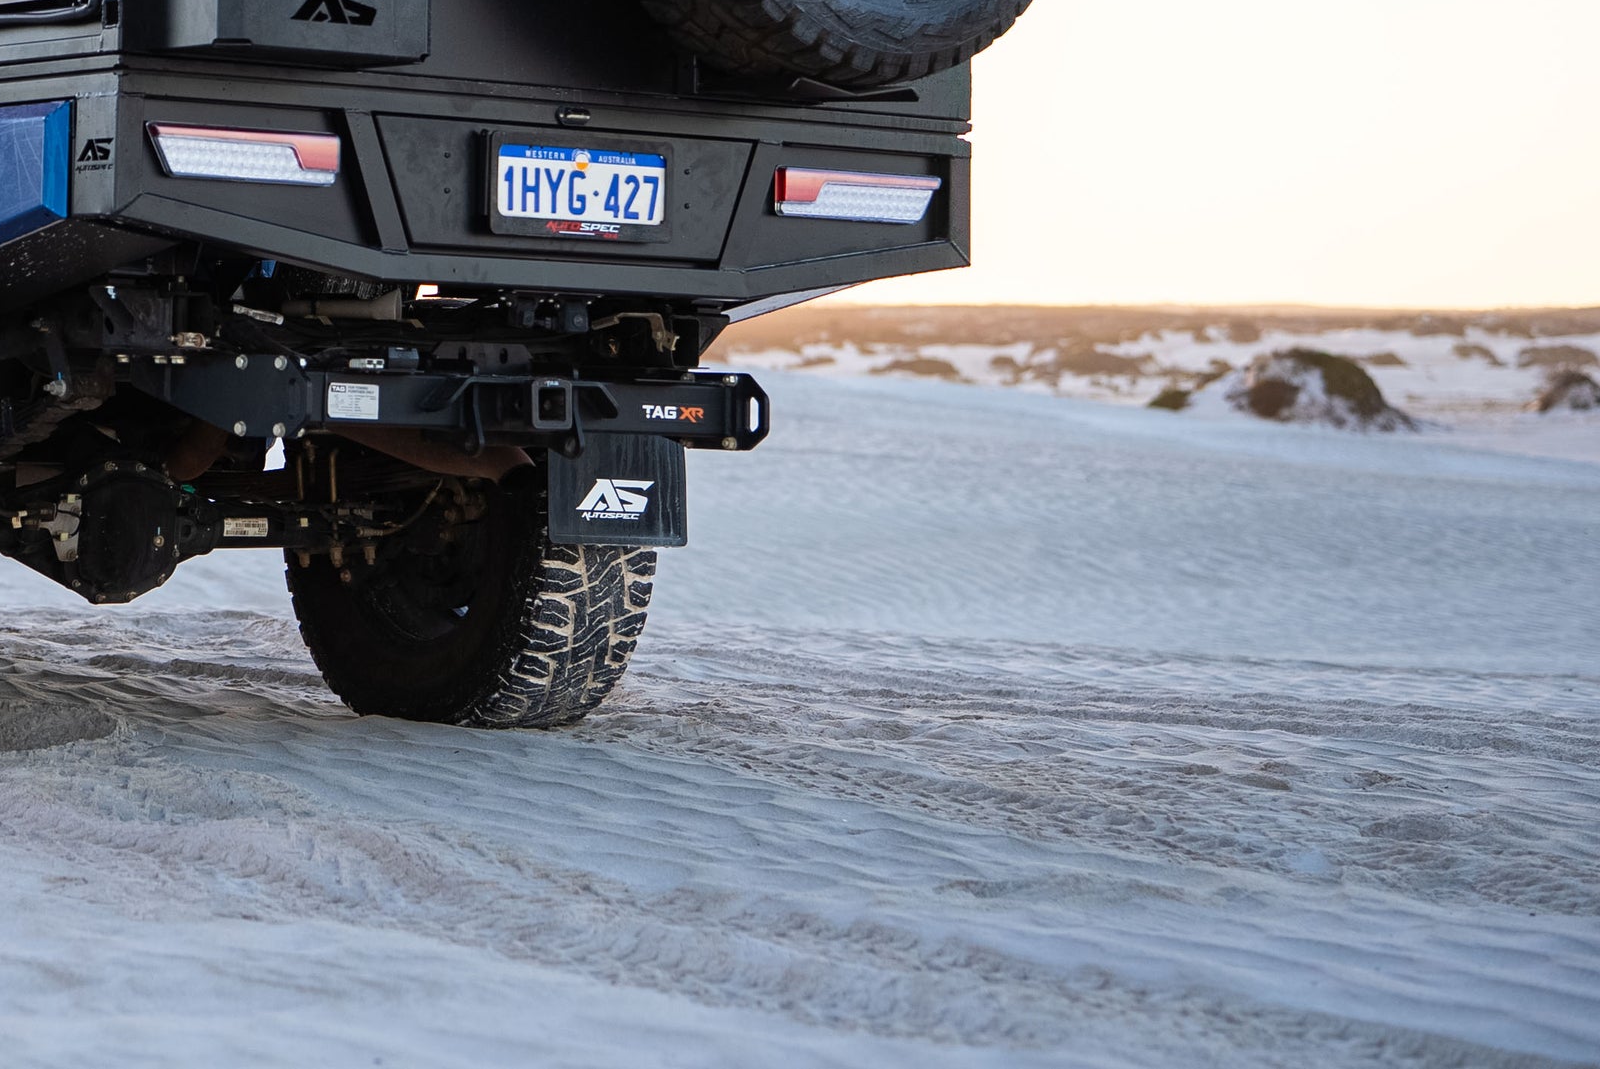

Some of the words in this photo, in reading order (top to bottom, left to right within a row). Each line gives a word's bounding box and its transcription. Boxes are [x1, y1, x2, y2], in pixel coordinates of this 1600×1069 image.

[77, 137, 114, 162] AS
[525, 149, 565, 160] WESTERN
[598, 155, 636, 165] AUSTRALIA
[545, 220, 620, 233] AUTOSPEC
[642, 405, 677, 419] TAG
[679, 406, 704, 423] XR
[575, 478, 655, 513] AS
[581, 512, 640, 521] AUTOSPEC
